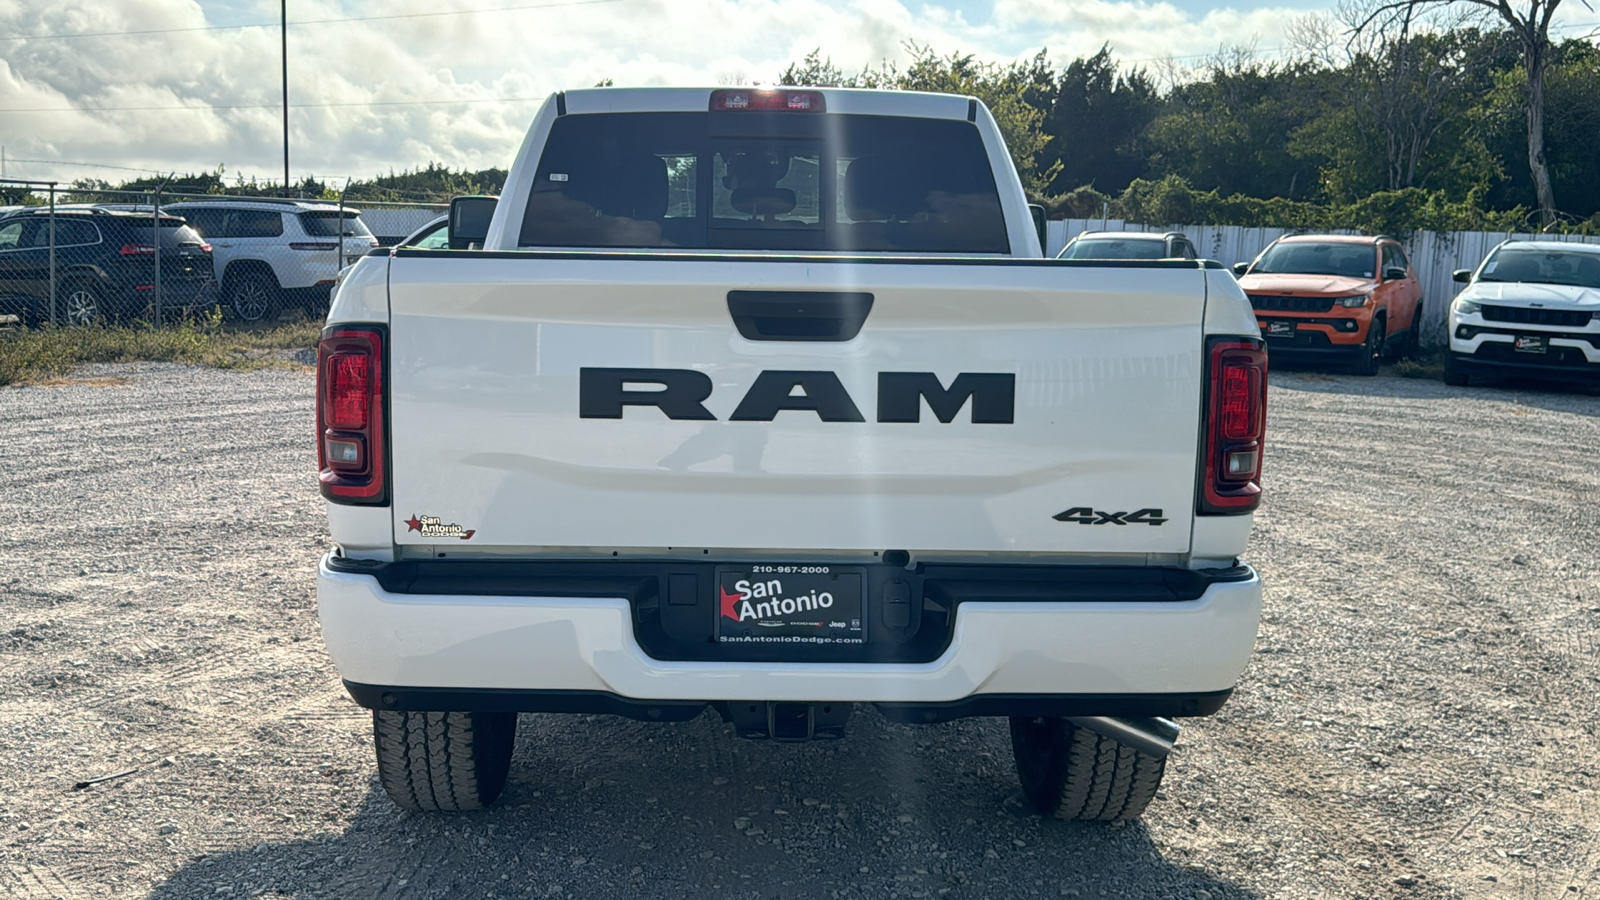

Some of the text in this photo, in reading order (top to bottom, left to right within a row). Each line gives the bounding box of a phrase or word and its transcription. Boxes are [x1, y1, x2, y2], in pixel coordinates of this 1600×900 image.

[579, 367, 1016, 424] RAM
[420, 515, 440, 524] San
[1051, 507, 1169, 526] 4x4
[421, 523, 462, 533] Antonio
[752, 565, 830, 574] 210-967-2000
[734, 579, 782, 600] San
[739, 589, 834, 622] Antonio
[828, 620, 847, 628] Jeep
[719, 636, 863, 644] SanAntonioDodge.com
